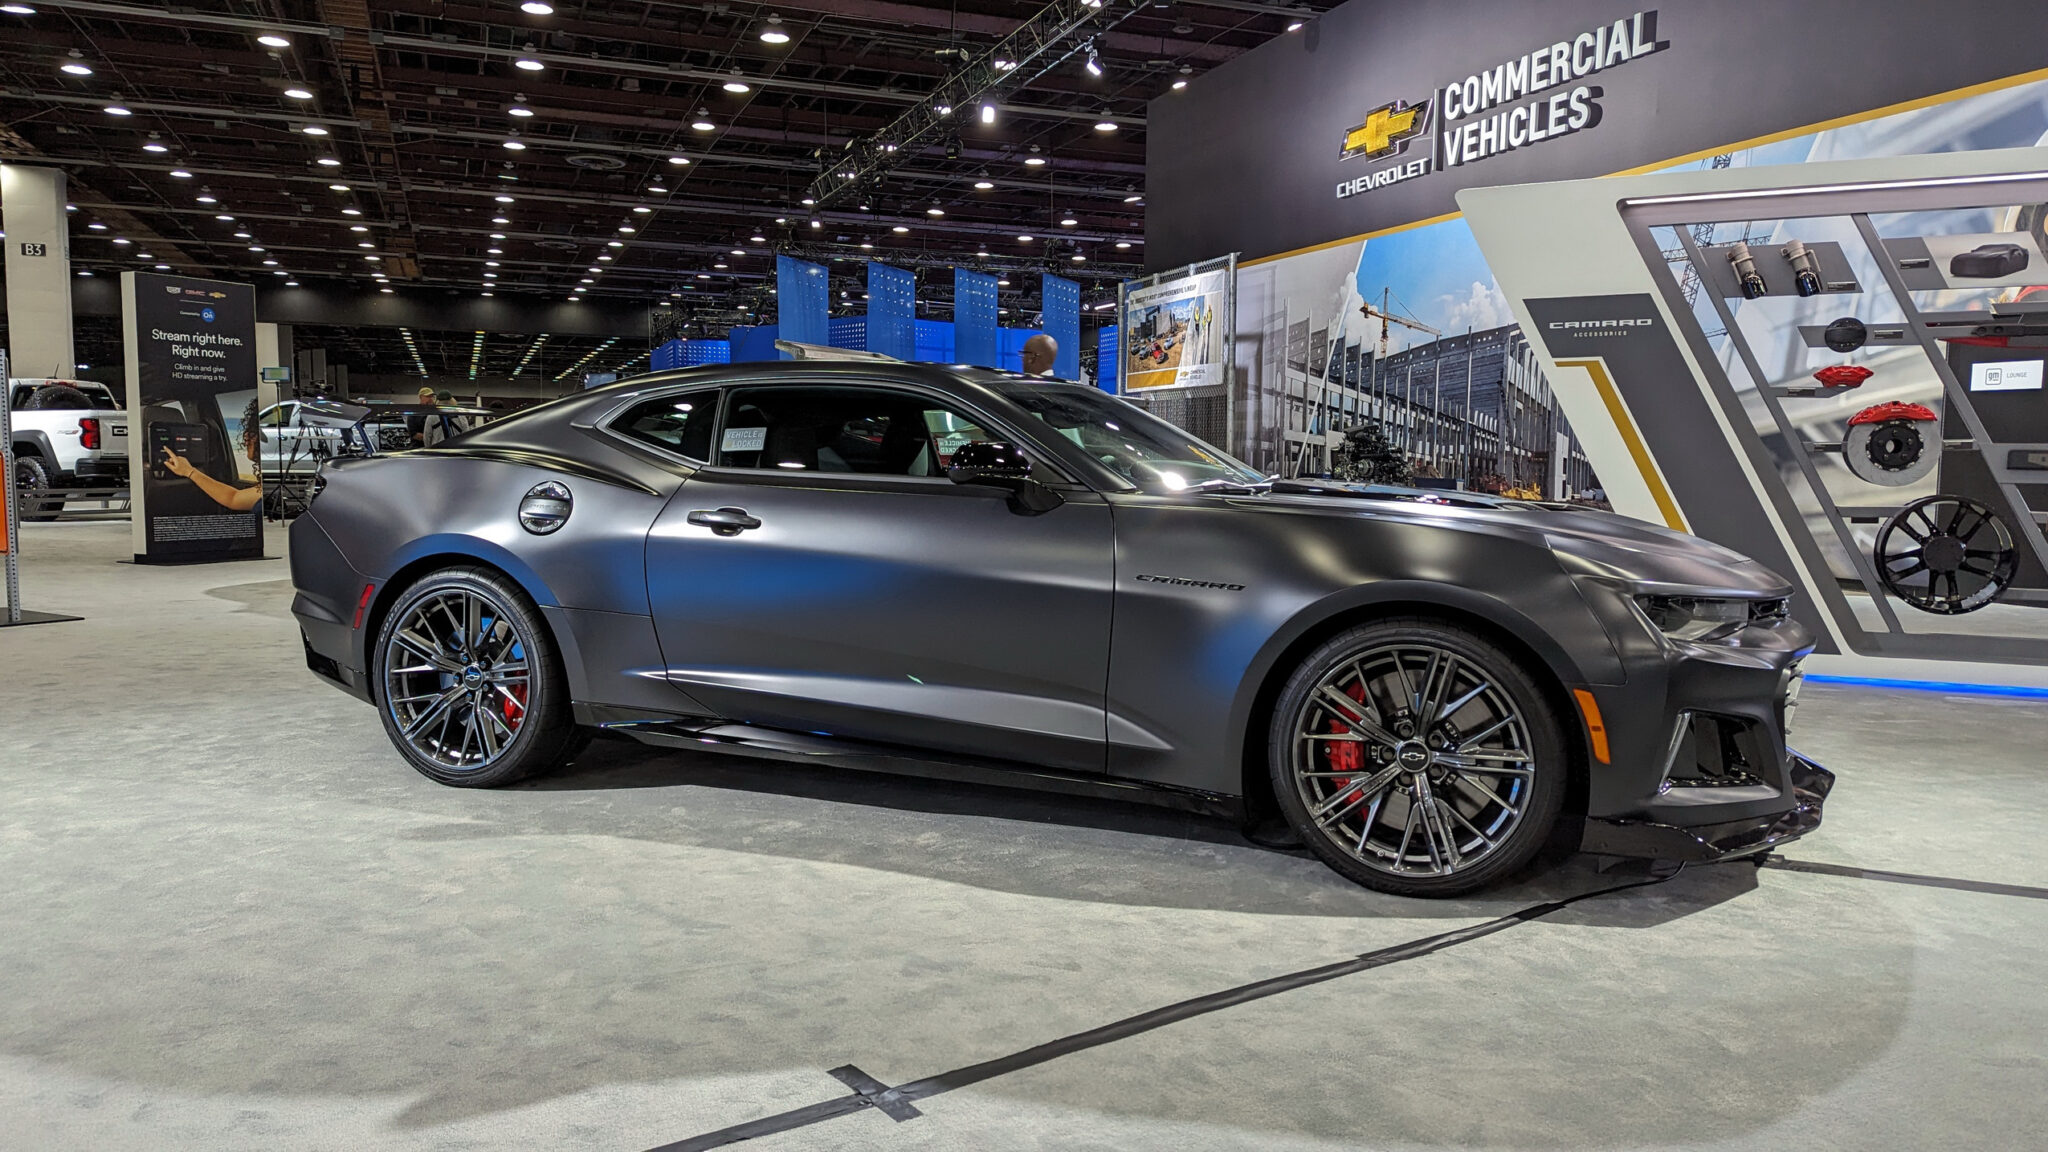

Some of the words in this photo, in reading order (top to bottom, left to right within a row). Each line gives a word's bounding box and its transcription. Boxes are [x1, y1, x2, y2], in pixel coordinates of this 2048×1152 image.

[1444, 11, 1656, 121] COMMERCIAL
[1444, 86, 1592, 167] VEHICLES
[1336, 157, 1429, 199] CHEVROLET
[25, 243, 42, 256] B3
[1550, 318, 1652, 329] CAMARO
[152, 328, 190, 342] Stream
[192, 331, 216, 346] right
[217, 333, 243, 347] here.
[172, 344, 199, 358] Right
[201, 348, 226, 359] now.
[174, 362, 193, 371] Climb
[200, 365, 212, 373] and
[212, 366, 225, 374] give
[172, 371, 182, 379] HD
[183, 373, 213, 382] streaming
[2006, 371, 2028, 379] LOUNGE
[726, 430, 758, 439] VEHICLE
[733, 439, 762, 448] LOCKED
[1136, 575, 1246, 591] CAMARO
